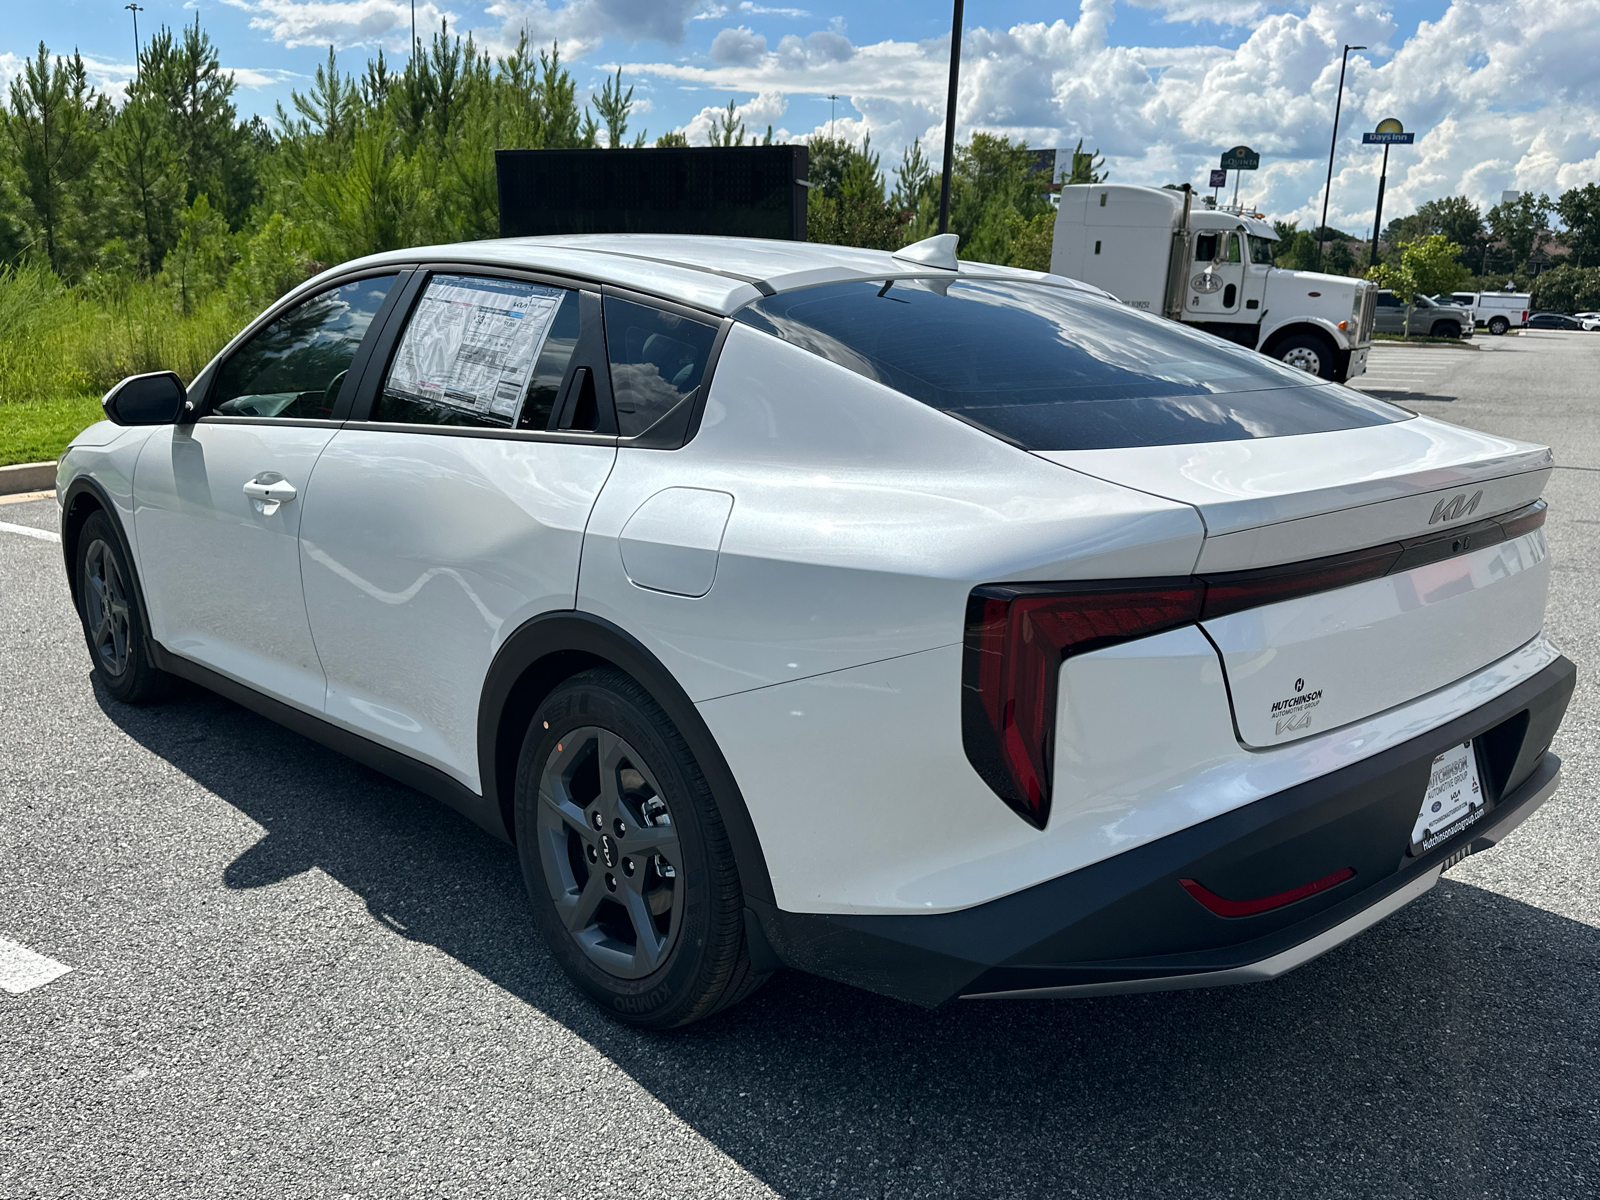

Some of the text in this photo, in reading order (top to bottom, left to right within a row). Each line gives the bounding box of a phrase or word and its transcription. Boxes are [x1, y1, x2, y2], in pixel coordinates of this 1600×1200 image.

[1227, 158, 1257, 166] QUINTA
[1428, 489, 1484, 525] KIA
[1270, 689, 1323, 712] HUTCHINSON
[1271, 699, 1320, 719] AUTOMOTIVE GROUP
[1275, 711, 1312, 736] K4
[1428, 777, 1454, 800] AUTOMOTIVE
[1453, 770, 1468, 785] GROUP
[1422, 808, 1485, 851] Hutchinsonautogroup.com
[613, 981, 673, 1013] KUMHO
